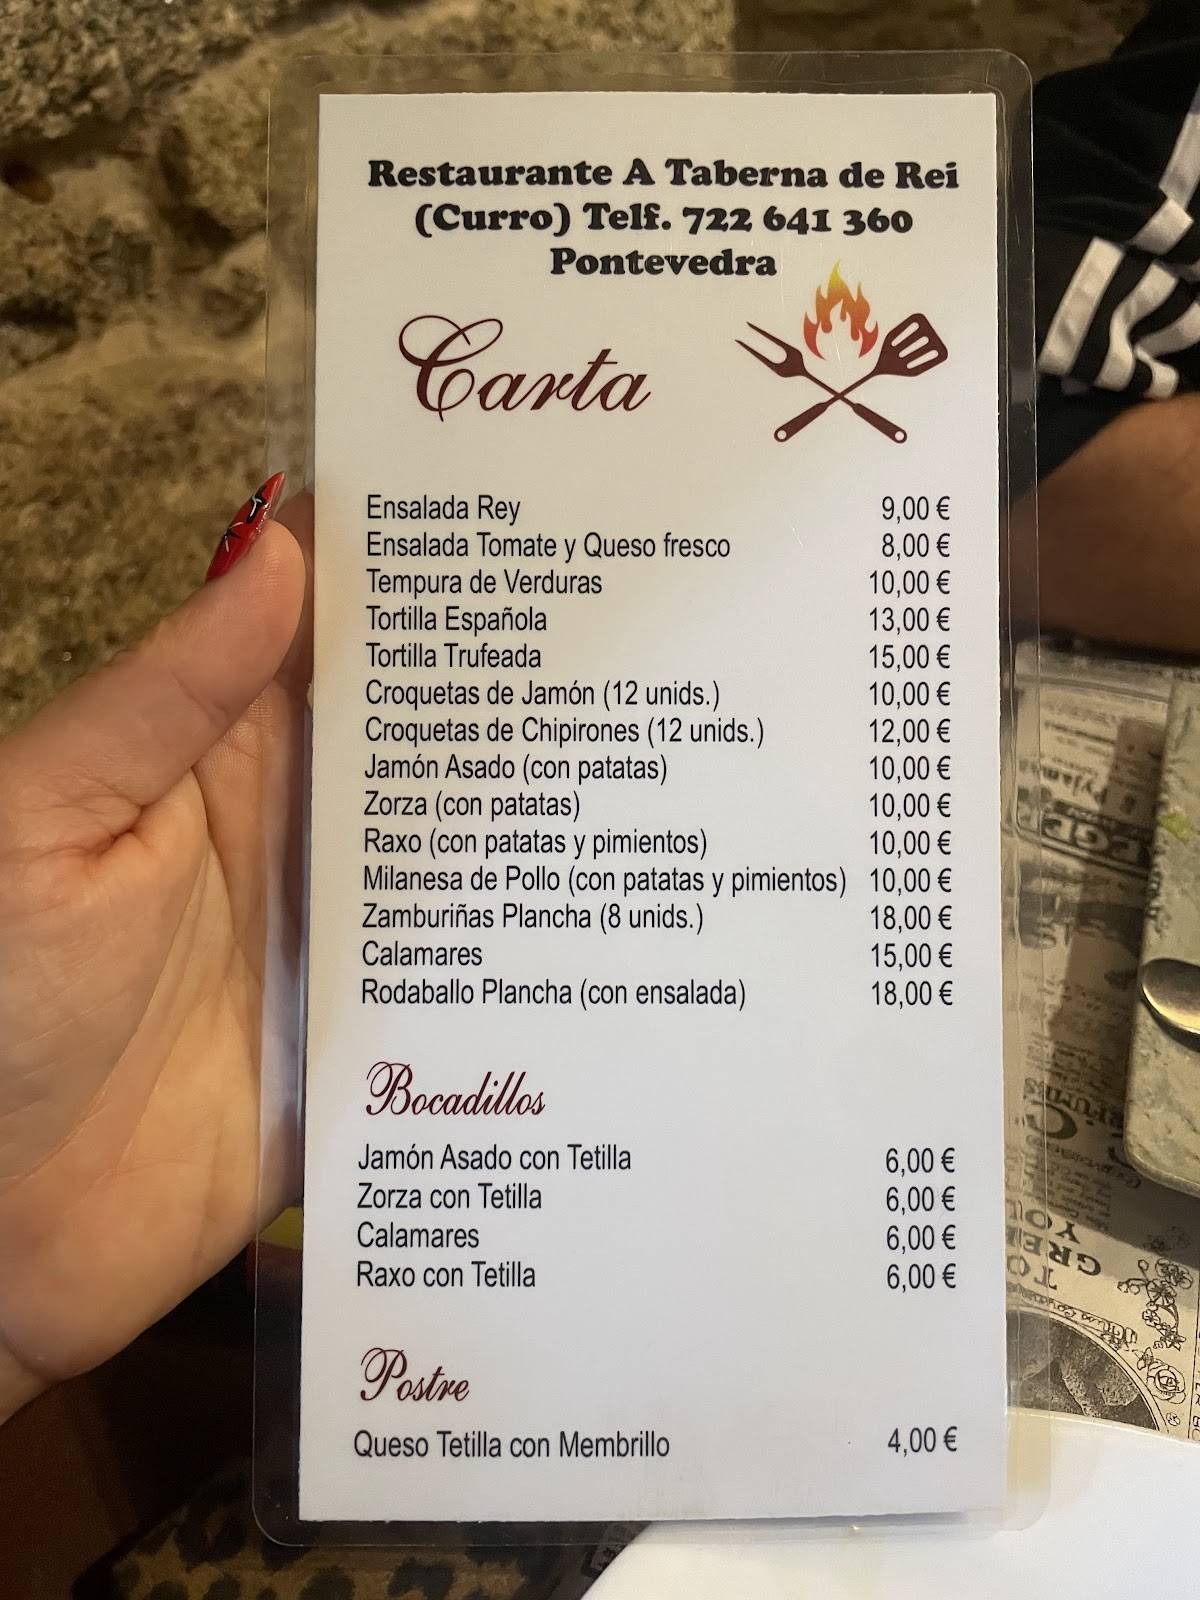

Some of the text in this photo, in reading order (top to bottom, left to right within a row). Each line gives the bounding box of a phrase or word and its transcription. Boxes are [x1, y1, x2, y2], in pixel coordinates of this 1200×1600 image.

[367, 157, 960, 190] Restaurante A Taberna de Rei
[414, 201, 914, 239] (Curro) Telf. 722 641 360
[549, 246, 778, 277] Pontevedra
[398, 314, 652, 423] Carta
[367, 493, 469, 520] Ensalada
[477, 494, 521, 527] Rey
[881, 495, 930, 525] 9,00
[367, 530, 469, 558] Ensalada
[475, 531, 557, 558] Tomate
[563, 538, 577, 565] y
[583, 531, 656, 559] Queso
[663, 531, 731, 558] fresco
[881, 532, 930, 562] 8,00
[365, 567, 463, 601] Tempura
[469, 568, 497, 595] de
[503, 568, 603, 595] Verduras
[869, 569, 930, 599] 10,00
[365, 604, 438, 631] Tortilla
[445, 605, 548, 638] Española
[869, 606, 930, 636] 13,00
[365, 641, 437, 668] Tortilla
[443, 642, 542, 669] Trufeada
[869, 643, 930, 673] 15,00
[365, 678, 480, 712] Croquetas
[486, 679, 514, 706] de
[521, 679, 595, 706] Jamón
[603, 679, 638, 712] (12
[645, 679, 720, 713] unids.)
[869, 680, 930, 711] 10,00
[365, 715, 480, 749] Croquetas
[486, 716, 514, 743] de
[521, 715, 640, 749] Chipirones
[647, 716, 683, 750] (12
[690, 716, 764, 750] unids.)
[869, 717, 930, 748] 12,00
[364, 752, 439, 779] Jamón
[444, 753, 516, 780] Asado
[522, 752, 570, 786] (con
[578, 753, 668, 787] patatas)
[869, 755, 930, 785] 10,00
[363, 789, 428, 817] Zorza
[435, 789, 482, 823] (con
[490, 789, 580, 824] patatas)
[869, 792, 931, 822] 10,00
[364, 827, 422, 854] Raxo
[429, 826, 477, 861] (con
[485, 828, 567, 861] patatas
[573, 834, 587, 861] y
[593, 827, 707, 861] pimientos)
[869, 829, 931, 860] 10,00
[363, 864, 463, 891] Milanesa
[470, 864, 498, 891] de
[505, 864, 561, 892] Pollo
[568, 864, 616, 898] (con
[623, 866, 705, 898] patatas
[711, 871, 725, 899] y
[731, 865, 847, 899] pimientos)
[870, 867, 931, 897] 10,00
[361, 902, 495, 929] Zamburiñas
[502, 902, 592, 929] Plancha
[599, 901, 622, 936] (8
[628, 902, 704, 936] unids.)
[870, 904, 932, 935] 18,00
[361, 939, 483, 967] Calamares
[871, 942, 932, 973] 15,00
[361, 977, 475, 1005] Rodaballo
[482, 977, 573, 1005] Plancha
[580, 977, 628, 1012] (con
[635, 978, 746, 1012] ensalada)
[871, 980, 933, 1010] 18,00
[365, 1060, 546, 1116] Bocadillos
[357, 1143, 434, 1171] Jamón
[439, 1143, 513, 1171] Asado
[519, 1149, 560, 1171] con
[566, 1143, 632, 1171] Tetilla
[885, 1147, 935, 1178] 6,00
[356, 1181, 422, 1210] Zorza
[429, 1188, 470, 1210] con
[477, 1182, 542, 1210] Tetilla
[886, 1185, 935, 1216] 6,00
[356, 1220, 480, 1249] Calamares
[886, 1224, 936, 1255] 6,00
[356, 1260, 416, 1288] Raxo
[422, 1266, 464, 1288] con
[470, 1260, 536, 1288] Tetilla
[886, 1262, 936, 1294] 6,00
[1006, 1251, 1058, 1291] TO
[359, 1347, 470, 1403] Postre
[353, 1429, 430, 1459] Queso
[435, 1429, 502, 1459] Tetilla
[509, 1436, 550, 1459] con
[559, 1429, 670, 1459] Membrillo
[887, 1426, 937, 1458] 4,00
